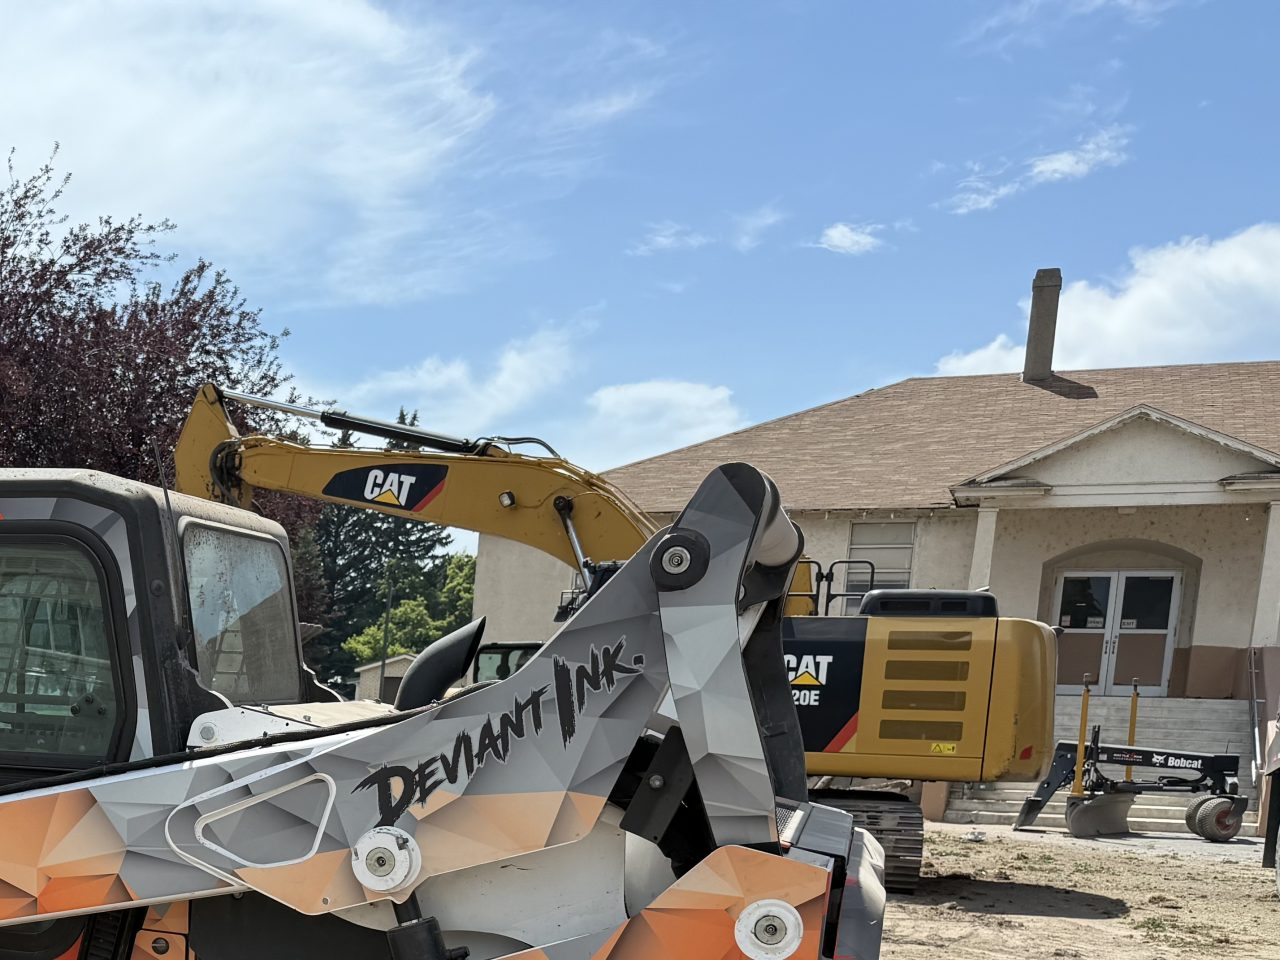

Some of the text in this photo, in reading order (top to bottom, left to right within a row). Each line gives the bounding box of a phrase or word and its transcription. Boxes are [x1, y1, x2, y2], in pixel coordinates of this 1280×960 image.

[364, 469, 416, 506] CAT
[783, 654, 833, 685] CAT
[350, 684, 551, 828] DEVIANT
[1167, 756, 1203, 768] Bobcat
